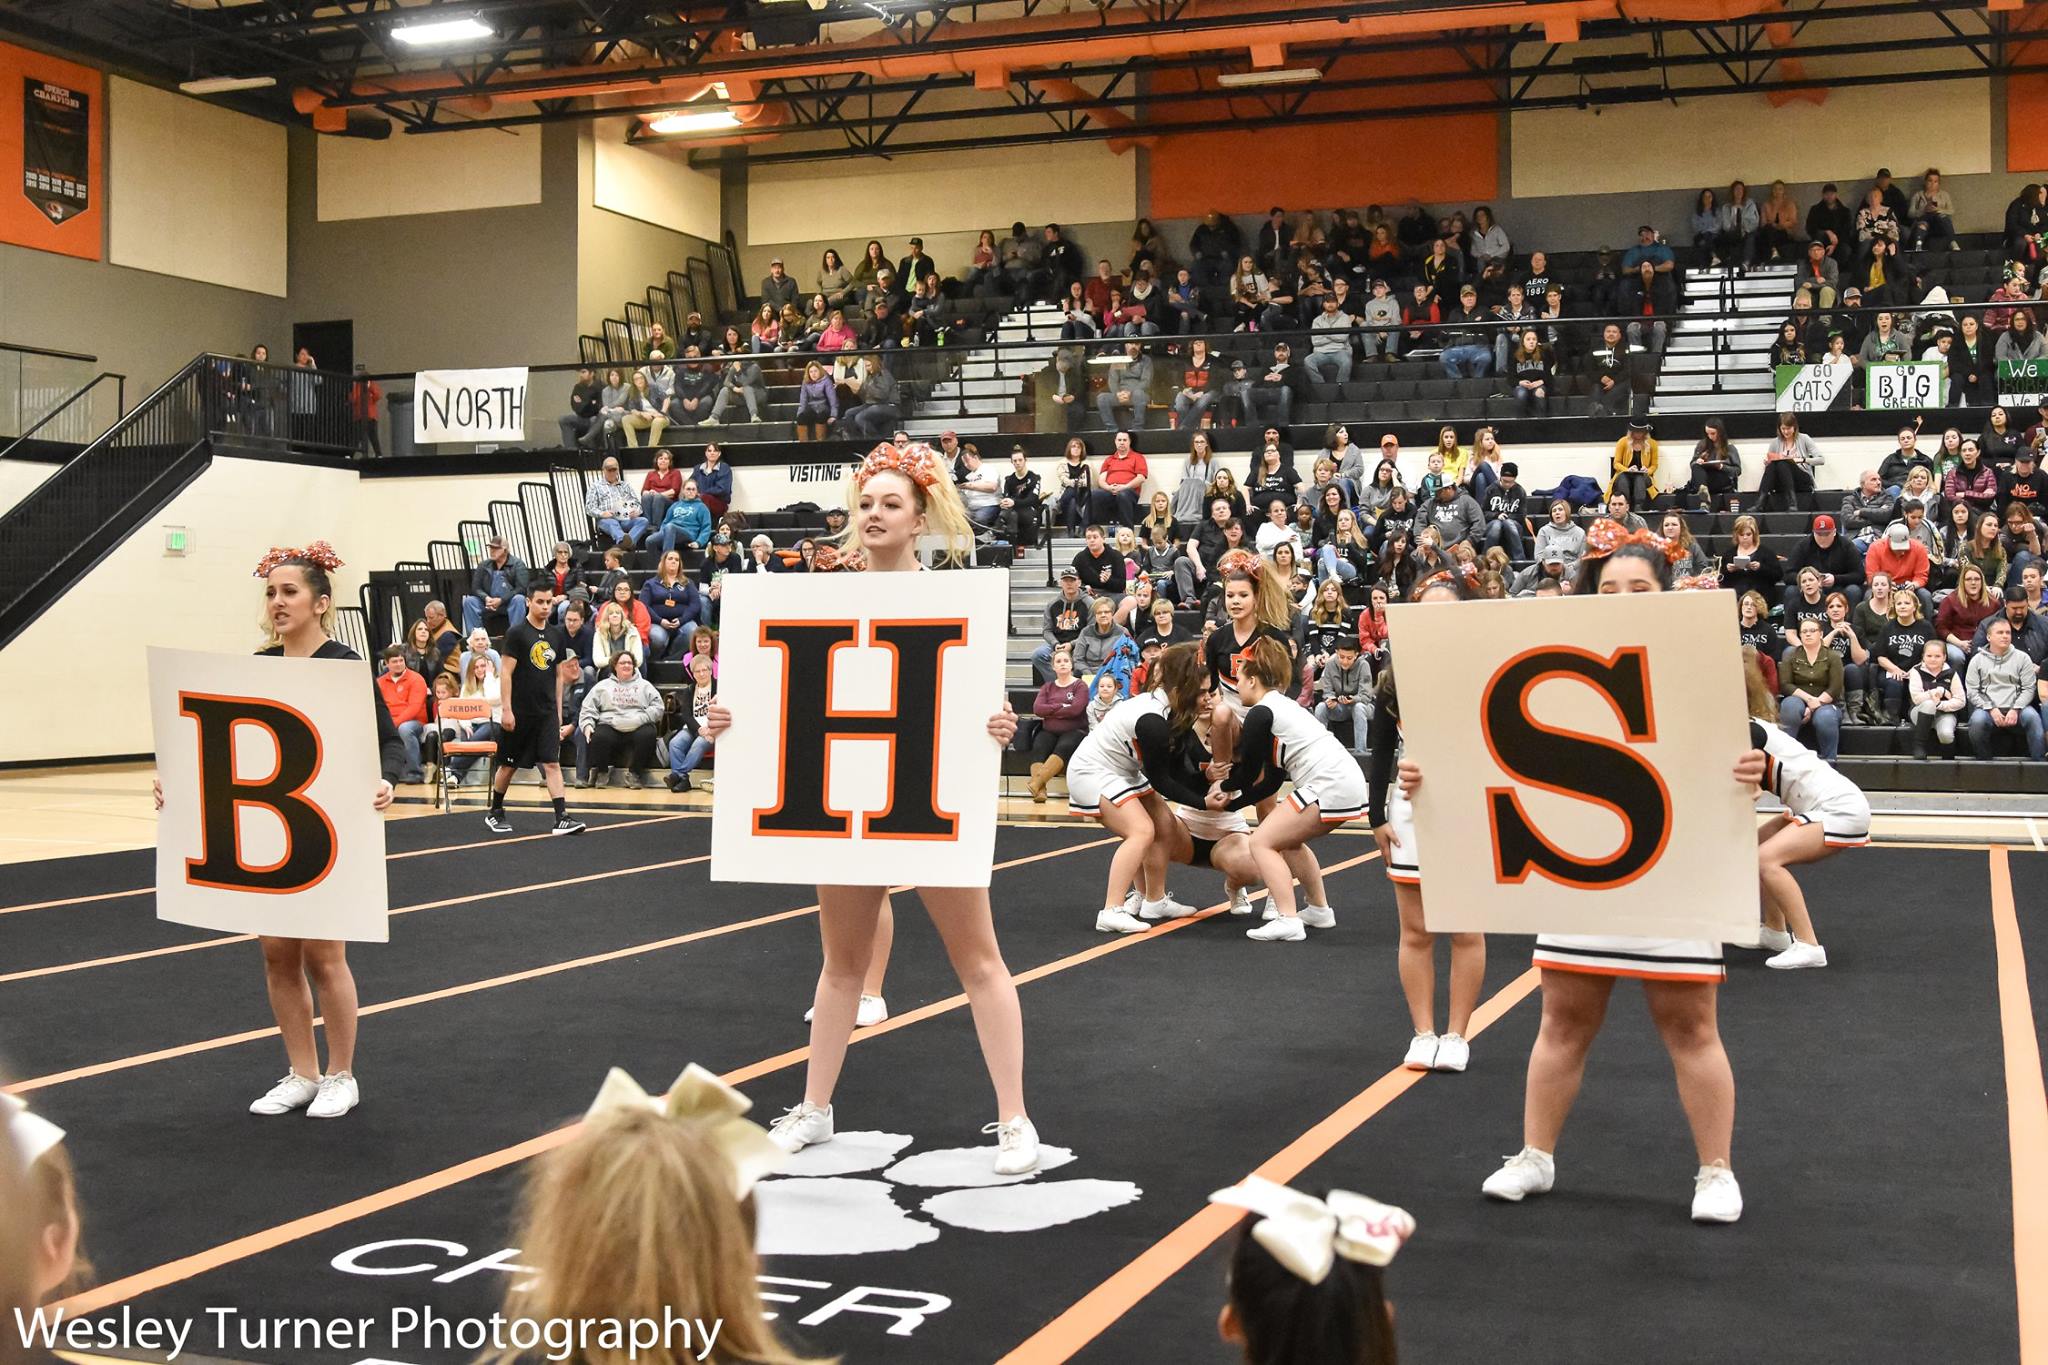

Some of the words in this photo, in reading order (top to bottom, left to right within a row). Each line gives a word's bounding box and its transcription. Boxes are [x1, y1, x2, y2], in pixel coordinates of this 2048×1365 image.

[33, 88, 80, 109] CHAMPIONS
[1526, 277, 1549, 286] AERO
[1813, 364, 1832, 378] GO
[1896, 365, 1915, 376] GO
[2008, 359, 2038, 378] We
[1793, 380, 1832, 401] CATS
[1879, 374, 1931, 399] BIG
[422, 385, 524, 432] NORTH
[1883, 396, 1925, 409] GREEN
[790, 464, 841, 482] VISITING
[1490, 496, 1520, 513] Pink
[1741, 633, 1768, 644] SMS
[1889, 634, 1925, 646] RSMS
[448, 704, 484, 713] JEROME
[752, 617, 969, 841] H
[1480, 644, 1673, 891] S
[178, 690, 339, 895] B
